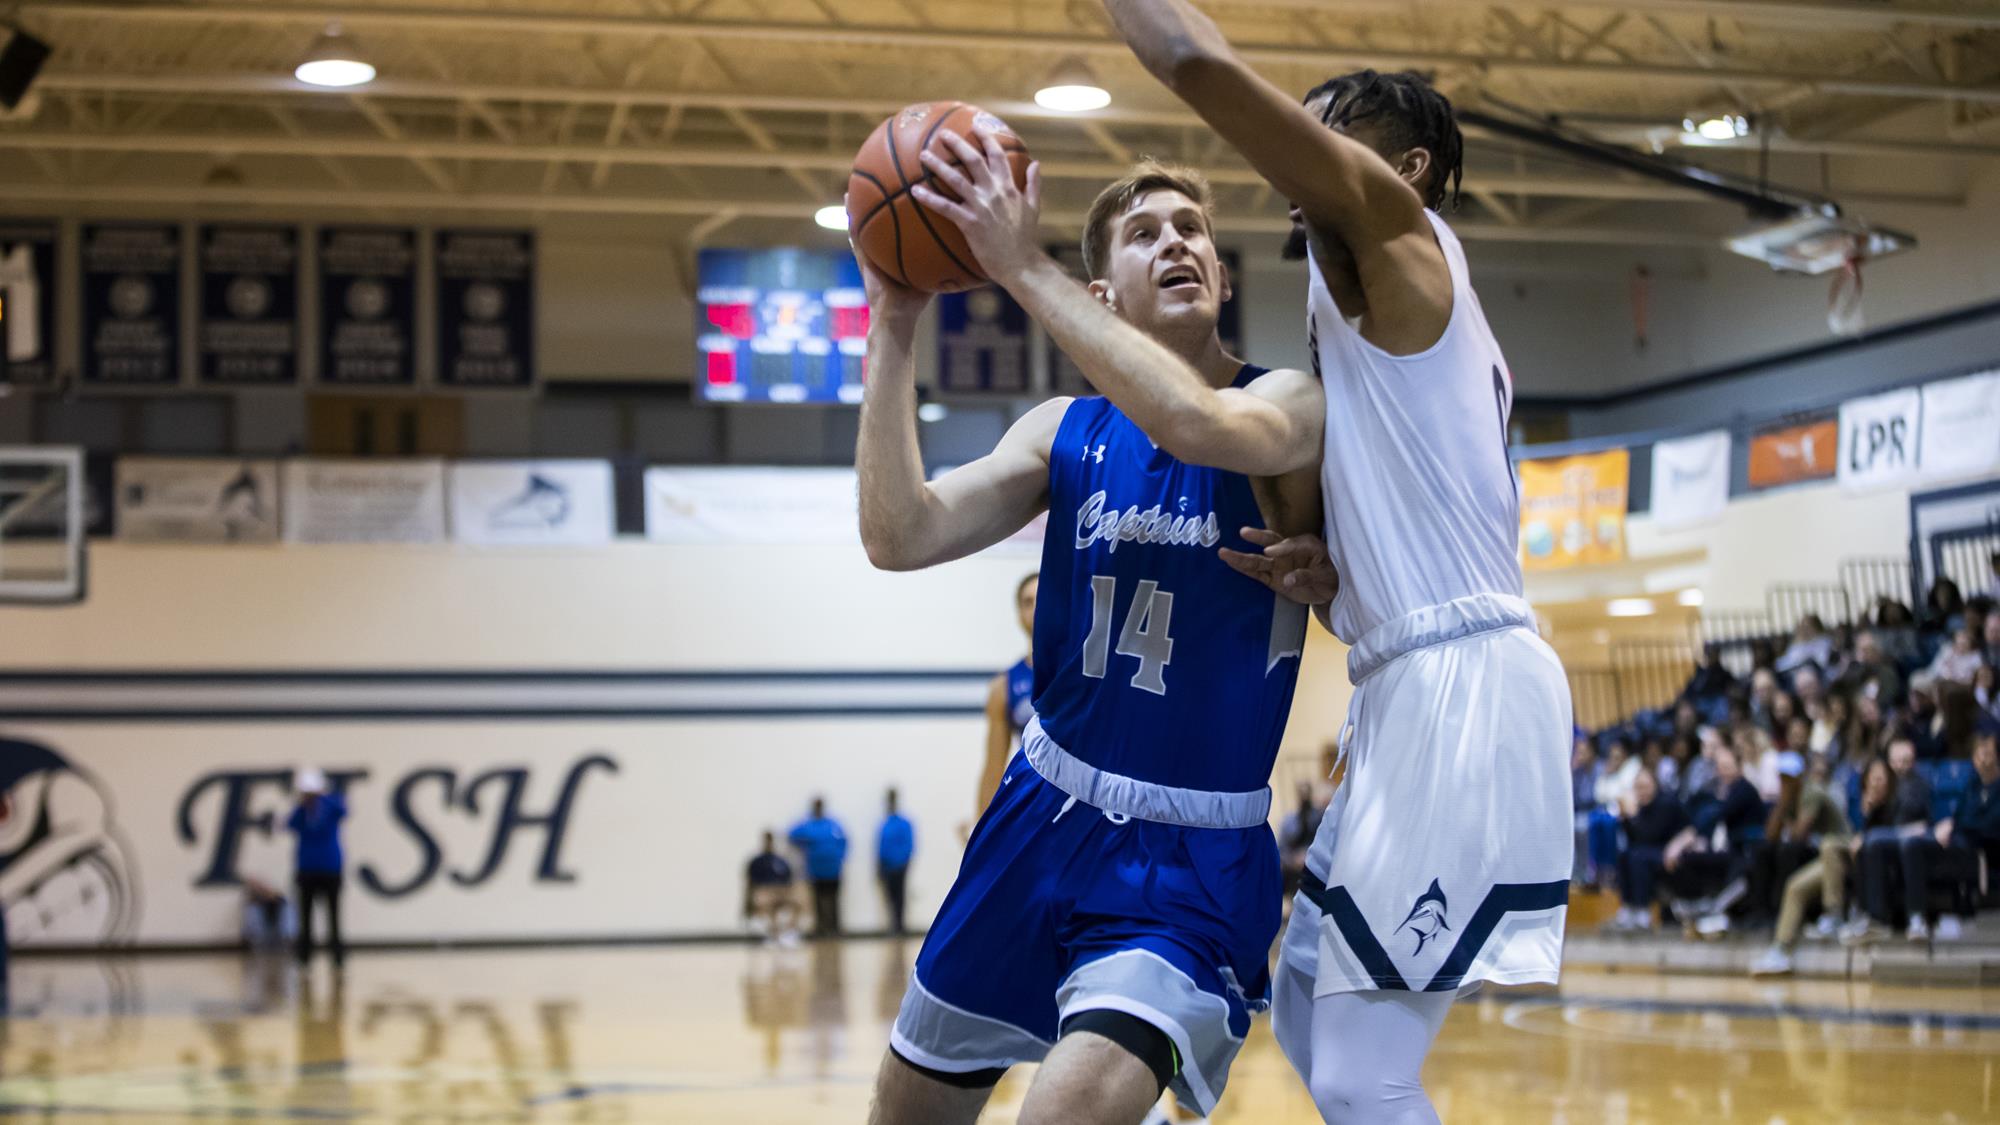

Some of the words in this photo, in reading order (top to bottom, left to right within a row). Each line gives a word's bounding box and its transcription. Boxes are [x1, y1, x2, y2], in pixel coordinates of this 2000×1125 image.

[1851, 416, 1906, 471] LPR
[1075, 490, 1220, 553] Captains
[1082, 575, 1174, 696] 14
